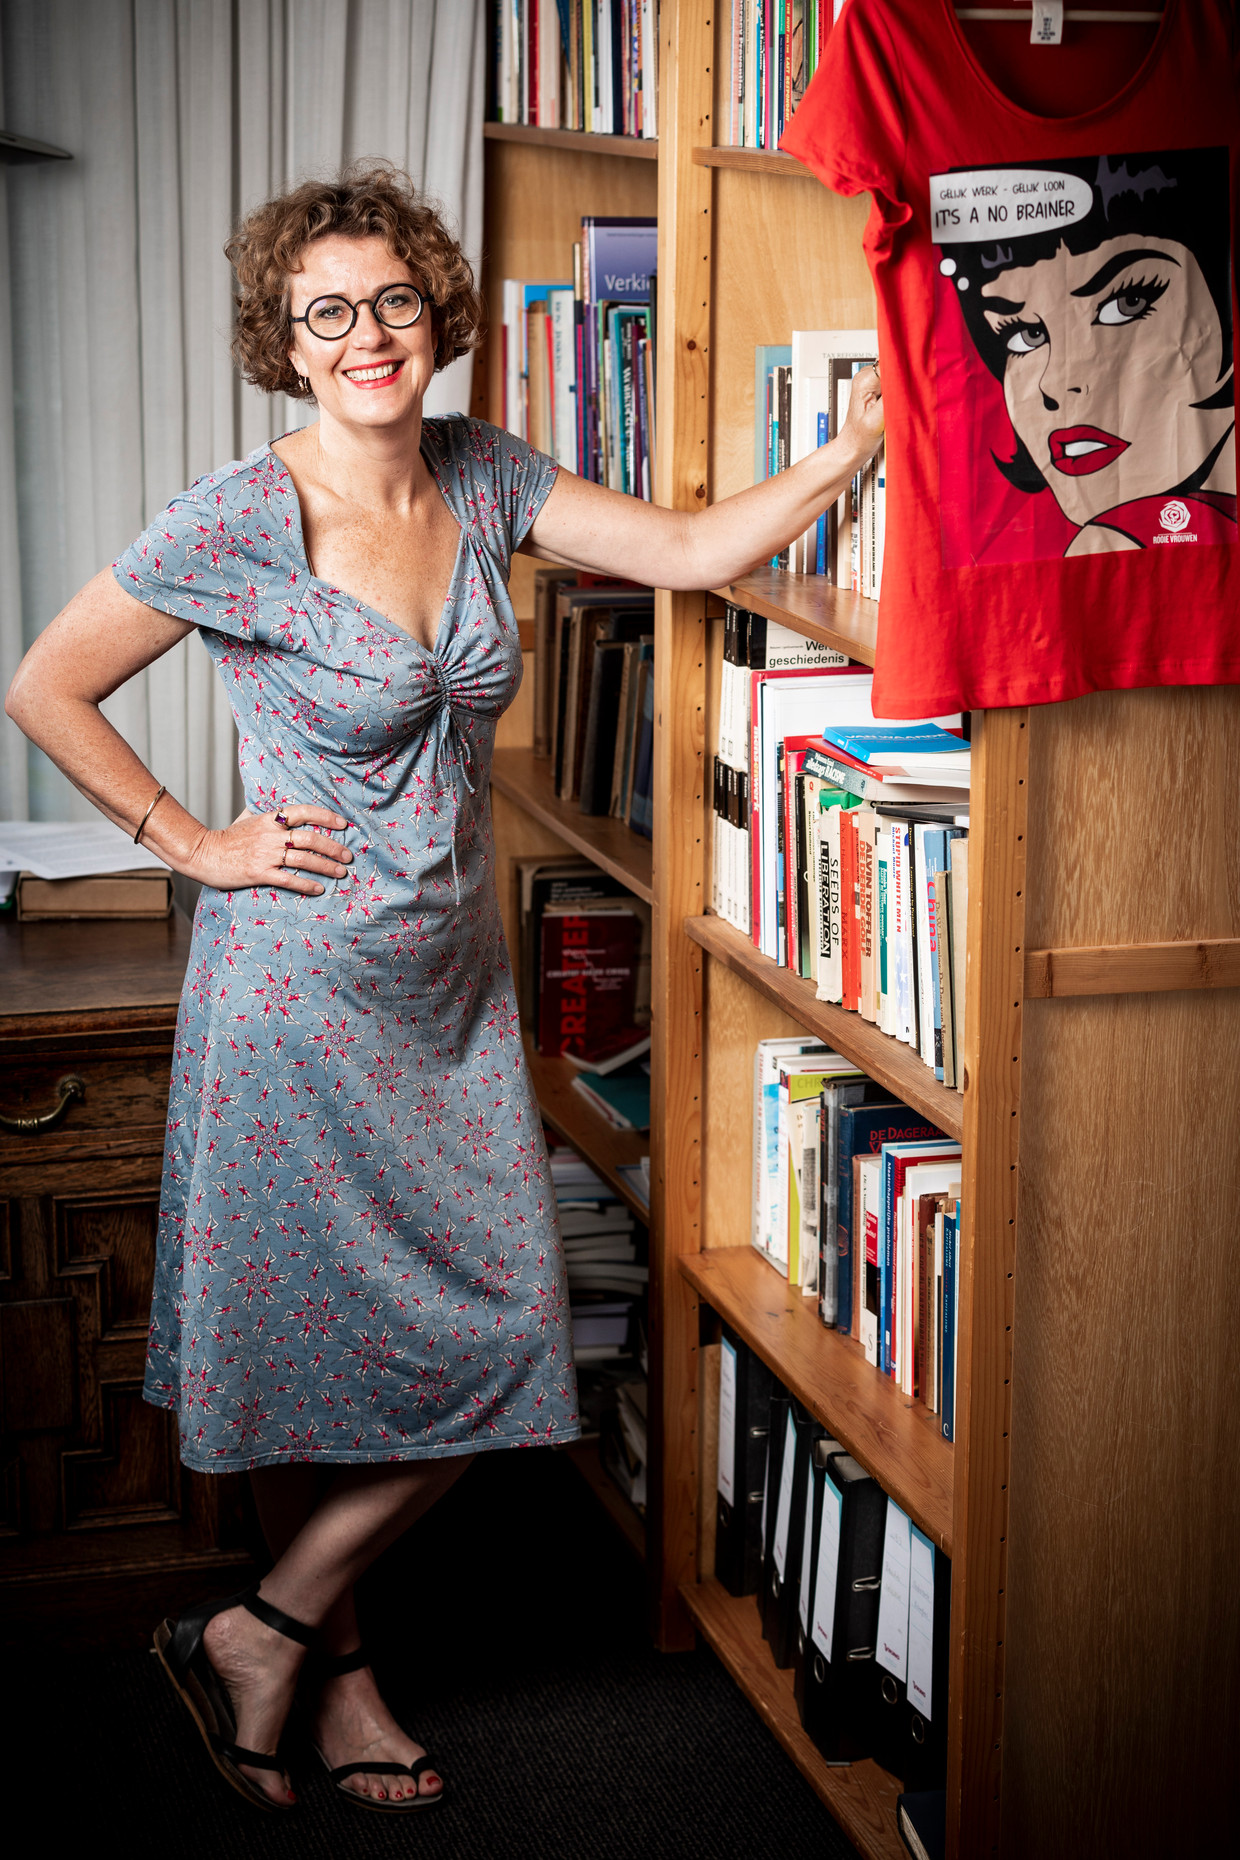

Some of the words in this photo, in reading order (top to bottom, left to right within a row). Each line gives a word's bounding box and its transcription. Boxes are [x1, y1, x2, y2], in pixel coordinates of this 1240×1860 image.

[940, 187, 966, 200] GELIJK
[972, 185, 998, 198] WERK
[1012, 182, 1040, 194] GELIJK
[1044, 180, 1066, 192] LOON
[935, 208, 961, 228] IT'S
[970, 207, 980, 224] A
[988, 205, 1008, 222] NO
[1016, 200, 1075, 221] BRAINER
[1152, 535, 1170, 544] ROOIE
[1170, 534, 1198, 543] VROUWEN
[769, 653, 845, 668] geschiedenis
[860, 840, 866, 862] DE
[830, 858, 840, 912] SEEDS
[821, 844, 830, 954] LIBERATION
[928, 881, 937, 952] China
[832, 921, 840, 945] OF
[560, 916, 590, 1054] CREATIEF
[870, 1130, 886, 1140] DE
